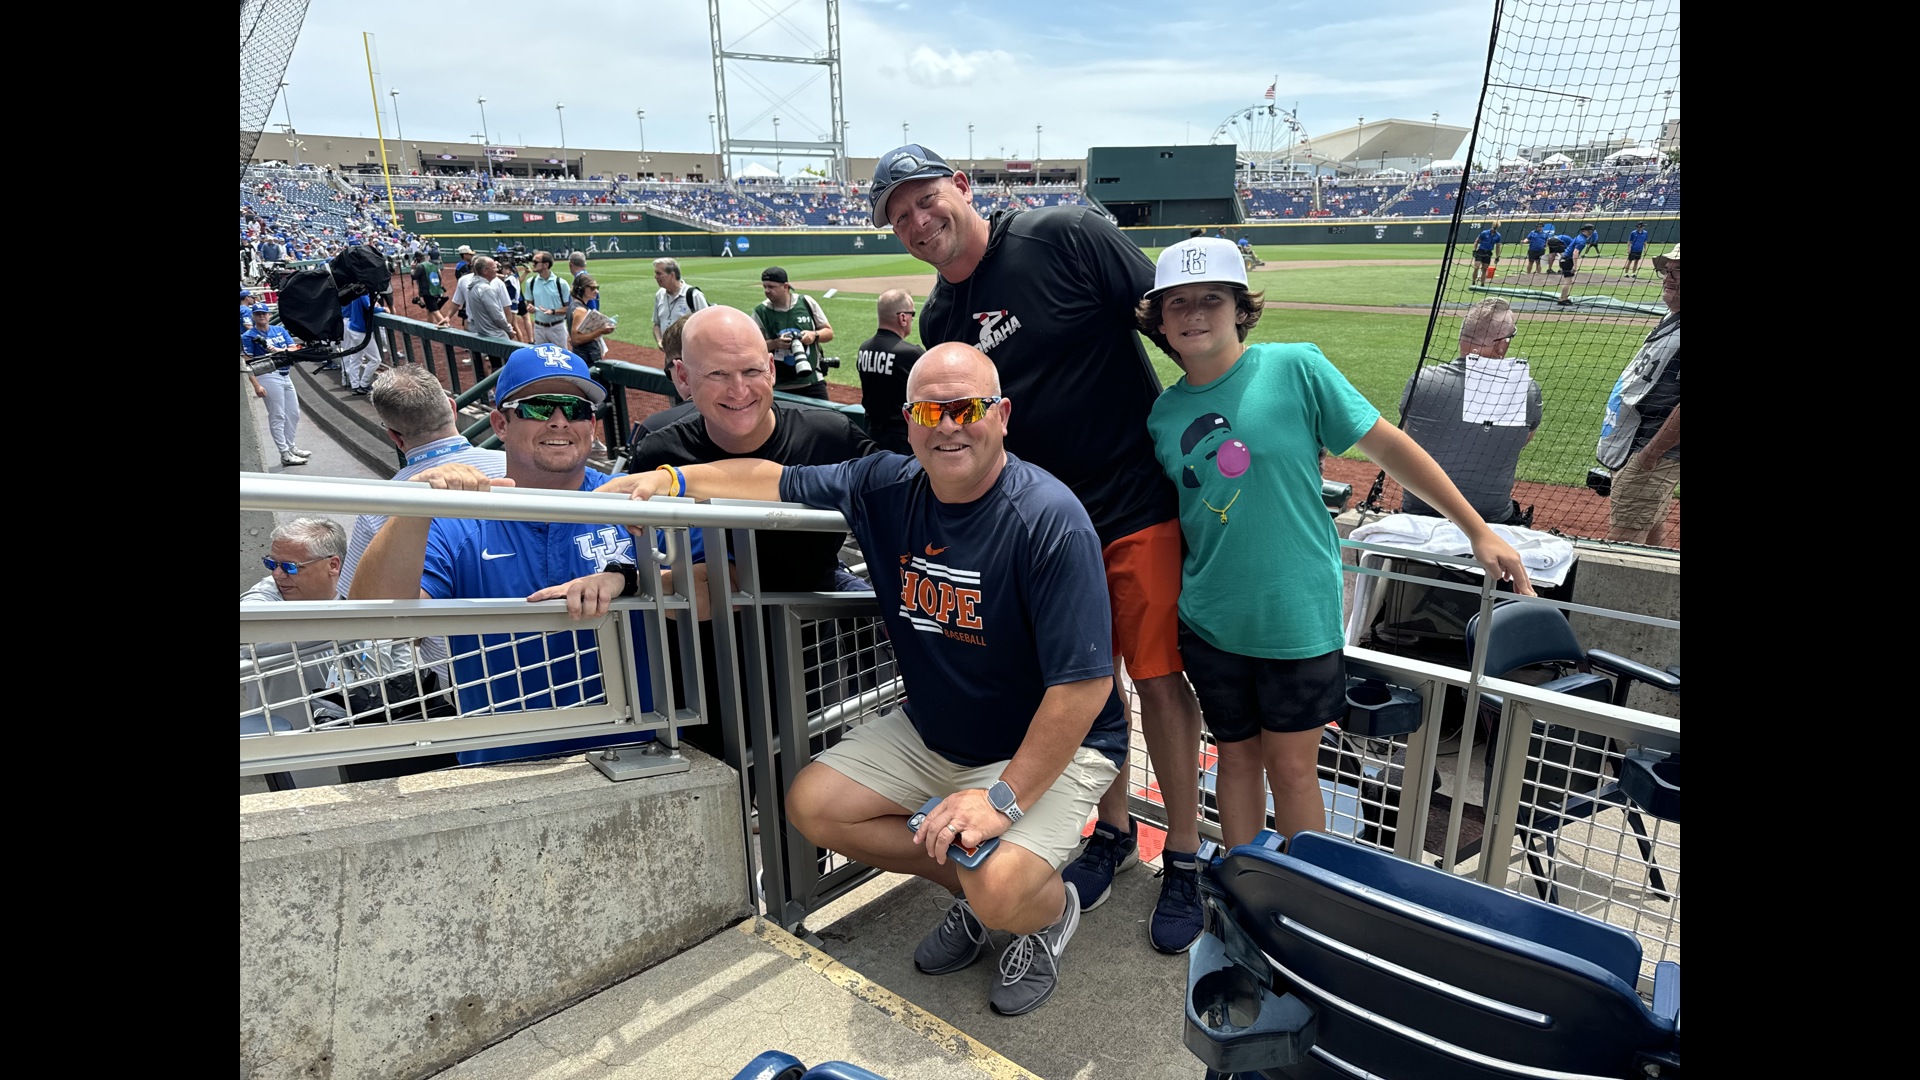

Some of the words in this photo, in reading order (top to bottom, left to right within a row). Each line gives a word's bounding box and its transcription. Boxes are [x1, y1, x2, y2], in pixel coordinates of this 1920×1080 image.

[796, 316, 810, 324] 391
[534, 345, 573, 371] UK
[857, 350, 896, 376] POLICE
[573, 526, 637, 574] UK
[899, 566, 984, 630] HOPE
[943, 628, 987, 646] BASEBALL
